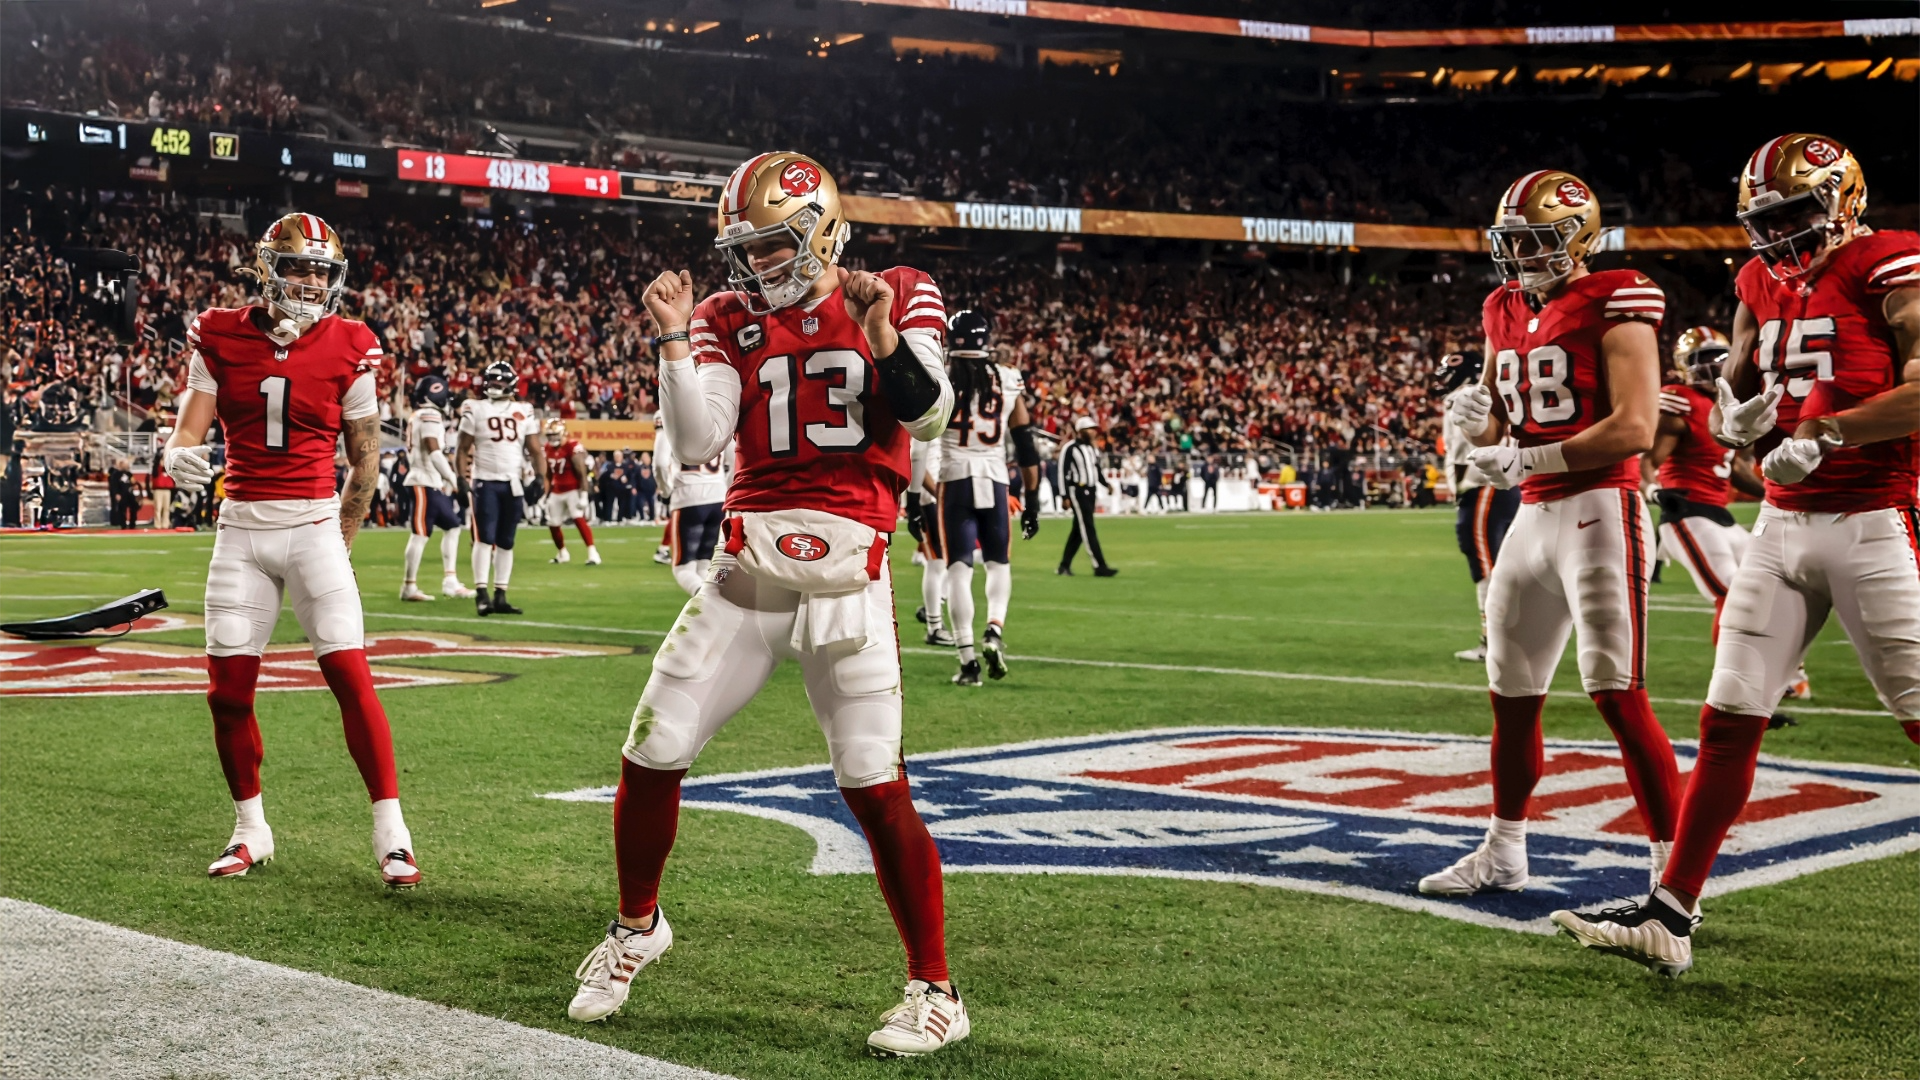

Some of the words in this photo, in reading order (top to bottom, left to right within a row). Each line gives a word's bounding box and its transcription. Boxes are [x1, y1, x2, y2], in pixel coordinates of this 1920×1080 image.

[150, 127, 191, 156] 4:52
[215, 136, 233, 156] 37
[333, 152, 353, 167] BALL
[353, 154, 367, 168] ON
[425, 155, 446, 180] 13
[485, 158, 551, 192] 49ERS
[955, 201, 1081, 233] TOUCHDOWN
[1242, 216, 1355, 247] TOUCHDOWN
[737, 323, 761, 347] C
[1759, 317, 1836, 399] 15
[1495, 345, 1580, 426] 88
[259, 375, 291, 452] 1
[758, 349, 872, 458] 13
[487, 417, 518, 442] 99
[790, 536, 821, 559] SF
